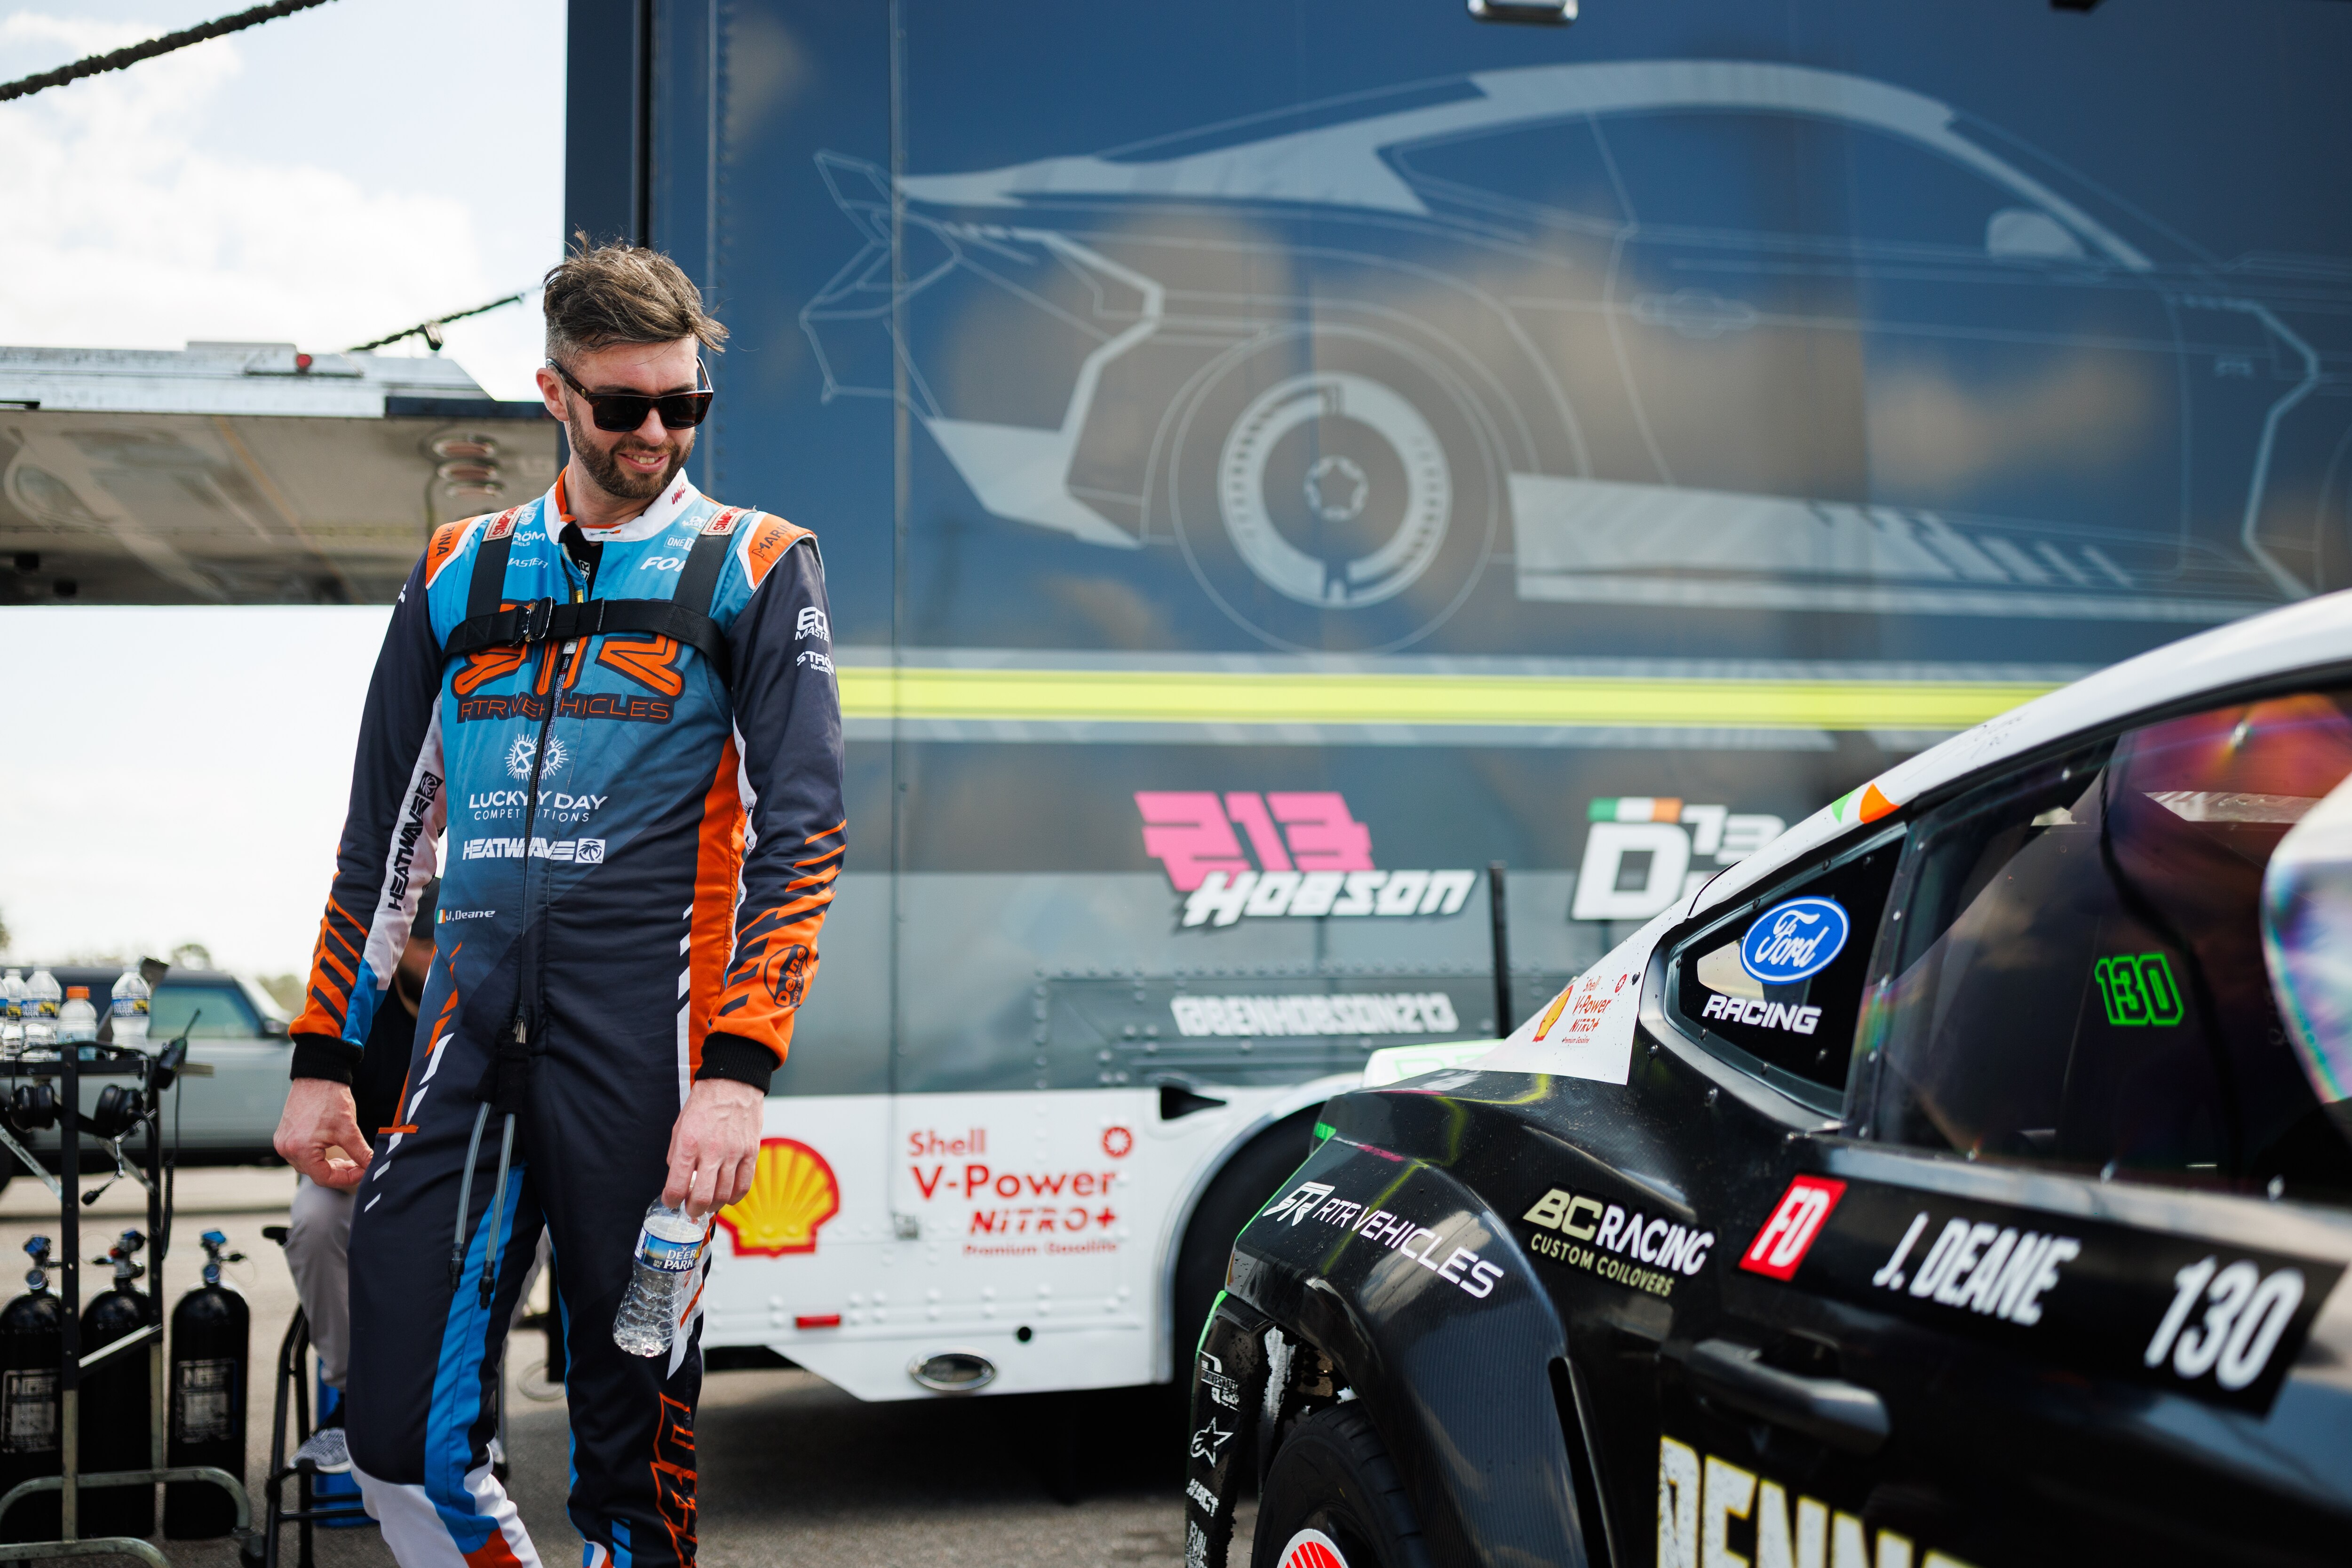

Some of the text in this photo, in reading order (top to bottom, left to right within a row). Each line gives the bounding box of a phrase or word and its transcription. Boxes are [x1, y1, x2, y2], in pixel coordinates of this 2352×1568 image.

[474, 808, 589, 822] COMPETITIONS
[554, 792, 608, 810] DAY
[387, 795, 431, 912] HEATWAVE
[462, 837, 576, 860] HEATWAVE
[1754, 909, 1830, 968] Ford
[1583, 976, 1602, 992] Shell
[2094, 953, 2184, 1027] 130
[1572, 995, 1613, 1015] V-Power
[1701, 994, 1822, 1035] RACING
[907, 1129, 986, 1157] Shell
[909, 1163, 1116, 1201] V-Power
[1748, 1183, 1830, 1268] FD
[663, 1258, 694, 1270] PARK
[666, 1249, 697, 1260] DEER
[1531, 1233, 1676, 1298] CUSTOM COILOVERS
[1872, 1211, 2081, 1327] J. DEANE
[2143, 1253, 2306, 1392] 130
